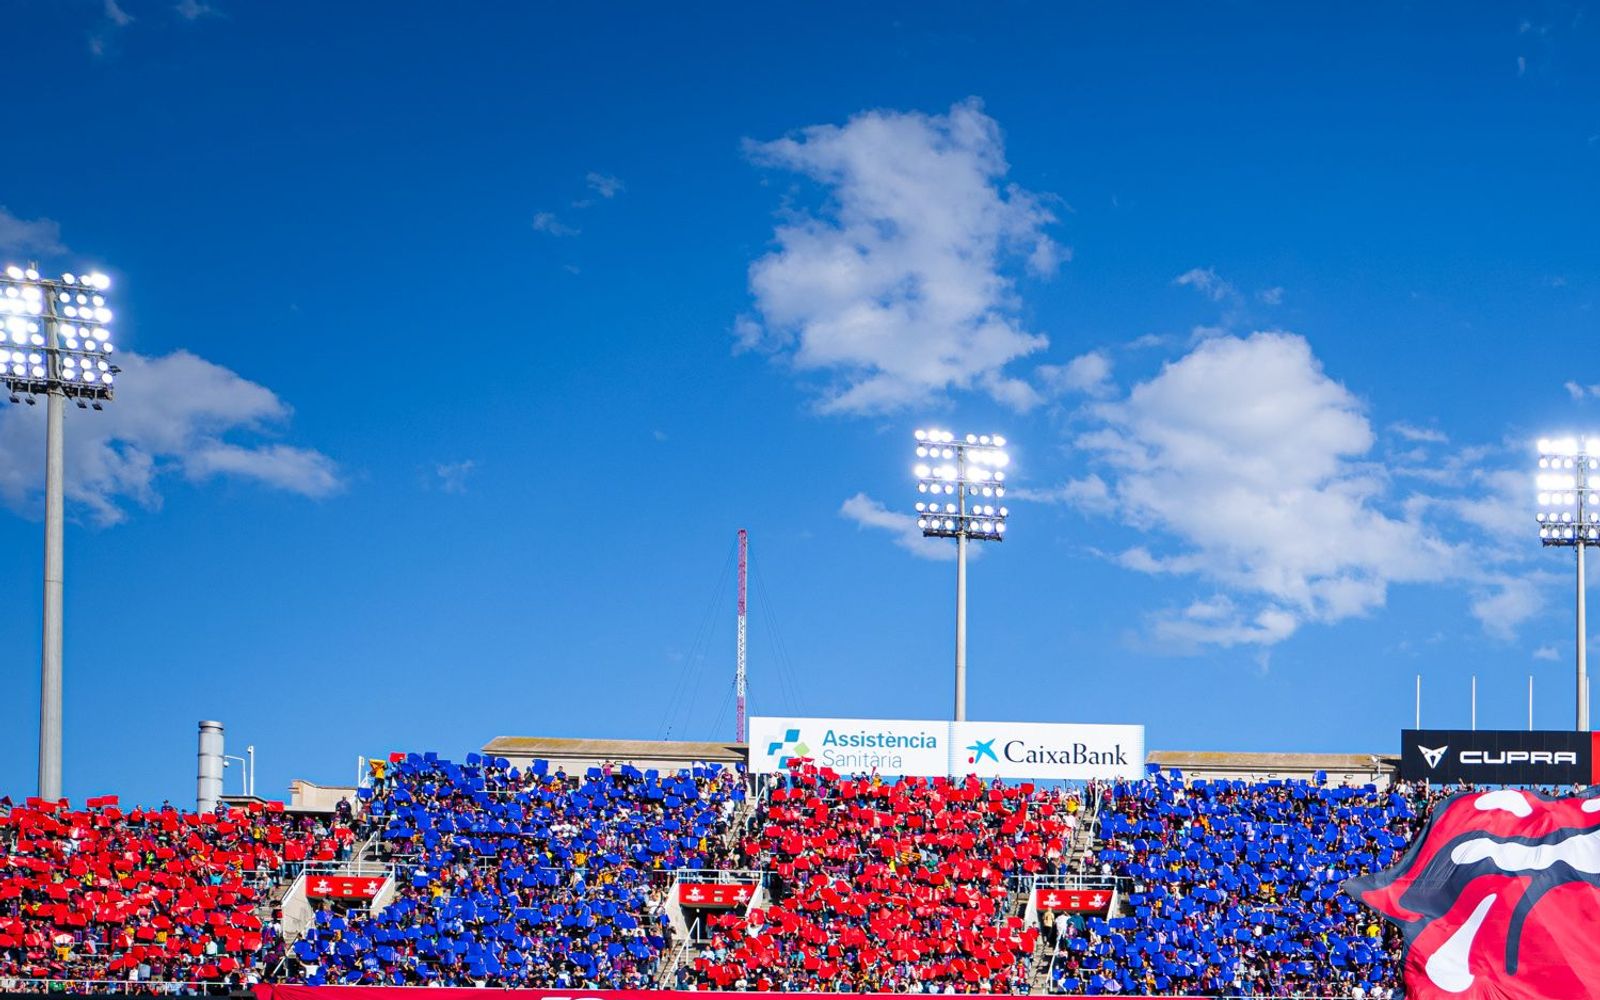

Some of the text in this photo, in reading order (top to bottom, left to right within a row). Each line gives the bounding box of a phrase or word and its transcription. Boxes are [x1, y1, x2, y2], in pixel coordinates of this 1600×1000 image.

[822, 729, 937, 749] Assistència
[822, 750, 902, 769] Sanitària
[1003, 740, 1129, 767] CaixaBank
[1459, 751, 1577, 765] CUPRA
